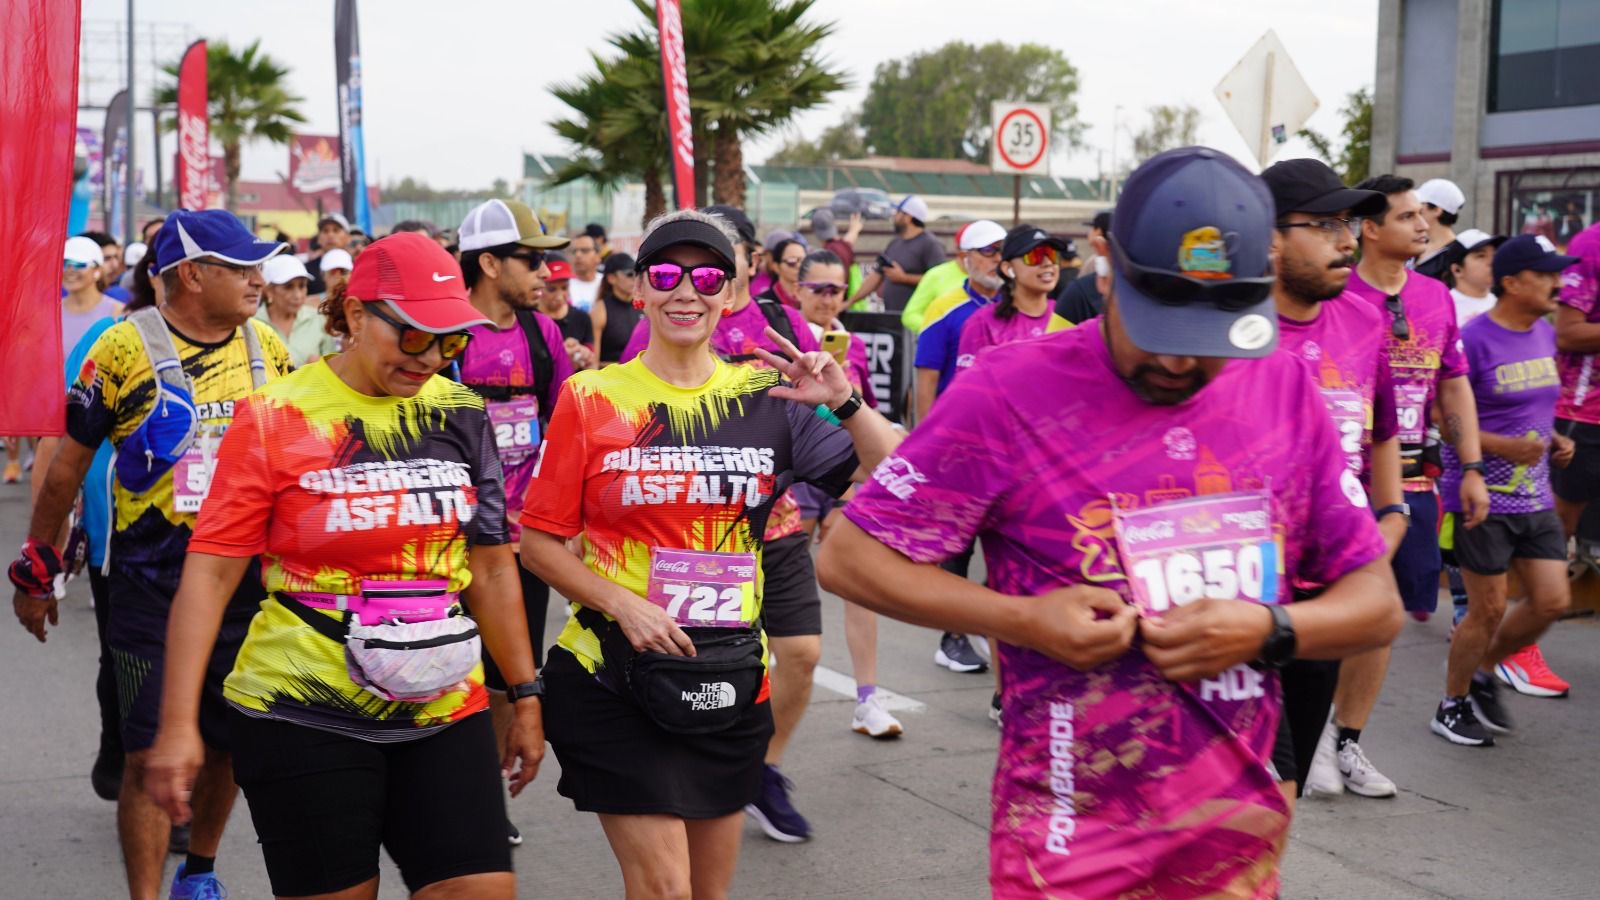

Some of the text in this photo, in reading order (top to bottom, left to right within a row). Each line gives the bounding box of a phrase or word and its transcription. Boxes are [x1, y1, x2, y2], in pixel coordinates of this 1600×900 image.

[1011, 122, 1034, 147] 35
[495, 422, 532, 448] 28
[601, 446, 775, 476] GUERREROS
[622, 475, 762, 507] ASFALTO
[325, 490, 473, 533] ASFALTO
[655, 560, 690, 573] Coca-Cola
[1133, 544, 1263, 612] 1650
[663, 584, 743, 621] 722
[681, 690, 720, 702] NORTH
[700, 682, 720, 693] THE
[691, 700, 718, 711] FACE
[1045, 701, 1076, 856] POWERADE
